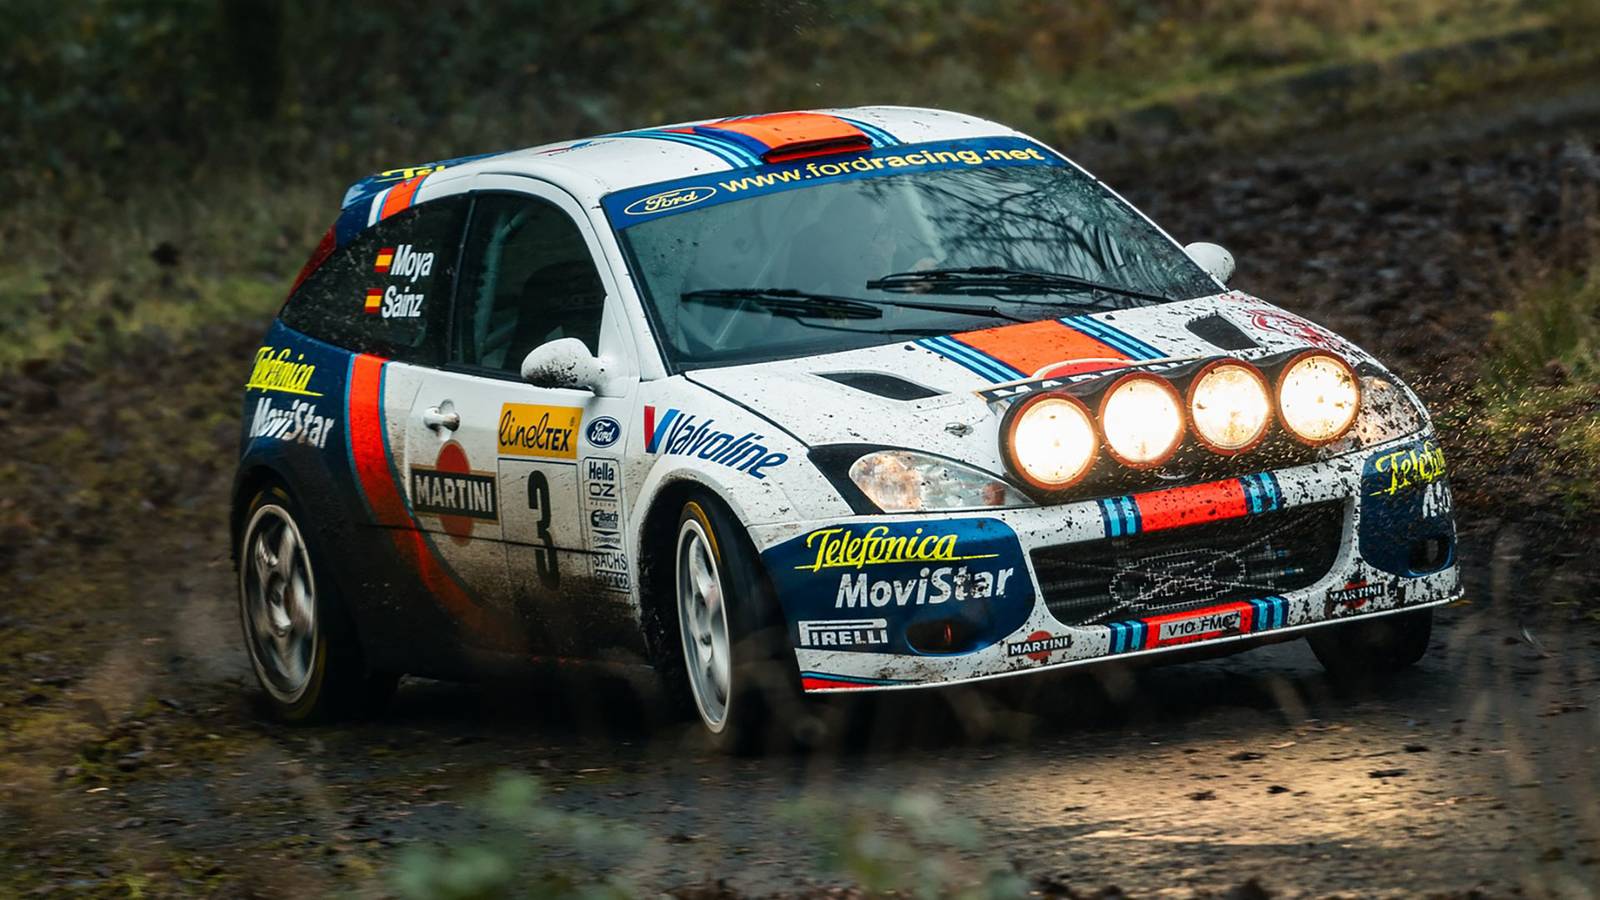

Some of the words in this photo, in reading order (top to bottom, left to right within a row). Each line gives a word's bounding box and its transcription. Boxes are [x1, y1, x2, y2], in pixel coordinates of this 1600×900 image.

[719, 148, 1044, 193] www.fordracing.net
[644, 190, 698, 211] Ford
[390, 244, 434, 283] Moya
[382, 285, 424, 318] Sainz
[249, 397, 335, 449] MoviStar
[591, 421, 615, 442] Ford
[664, 413, 788, 479] Valvoline
[589, 461, 614, 481] Hella
[415, 475, 493, 512] MARTINI
[589, 483, 615, 497] OZ
[527, 470, 560, 589] 3
[594, 552, 627, 570] SACHS
[835, 567, 1014, 608] MoviStar
[1329, 584, 1382, 602] MARTINI
[798, 618, 888, 646] PIRELLI
[1010, 636, 1068, 656] MARTINI
